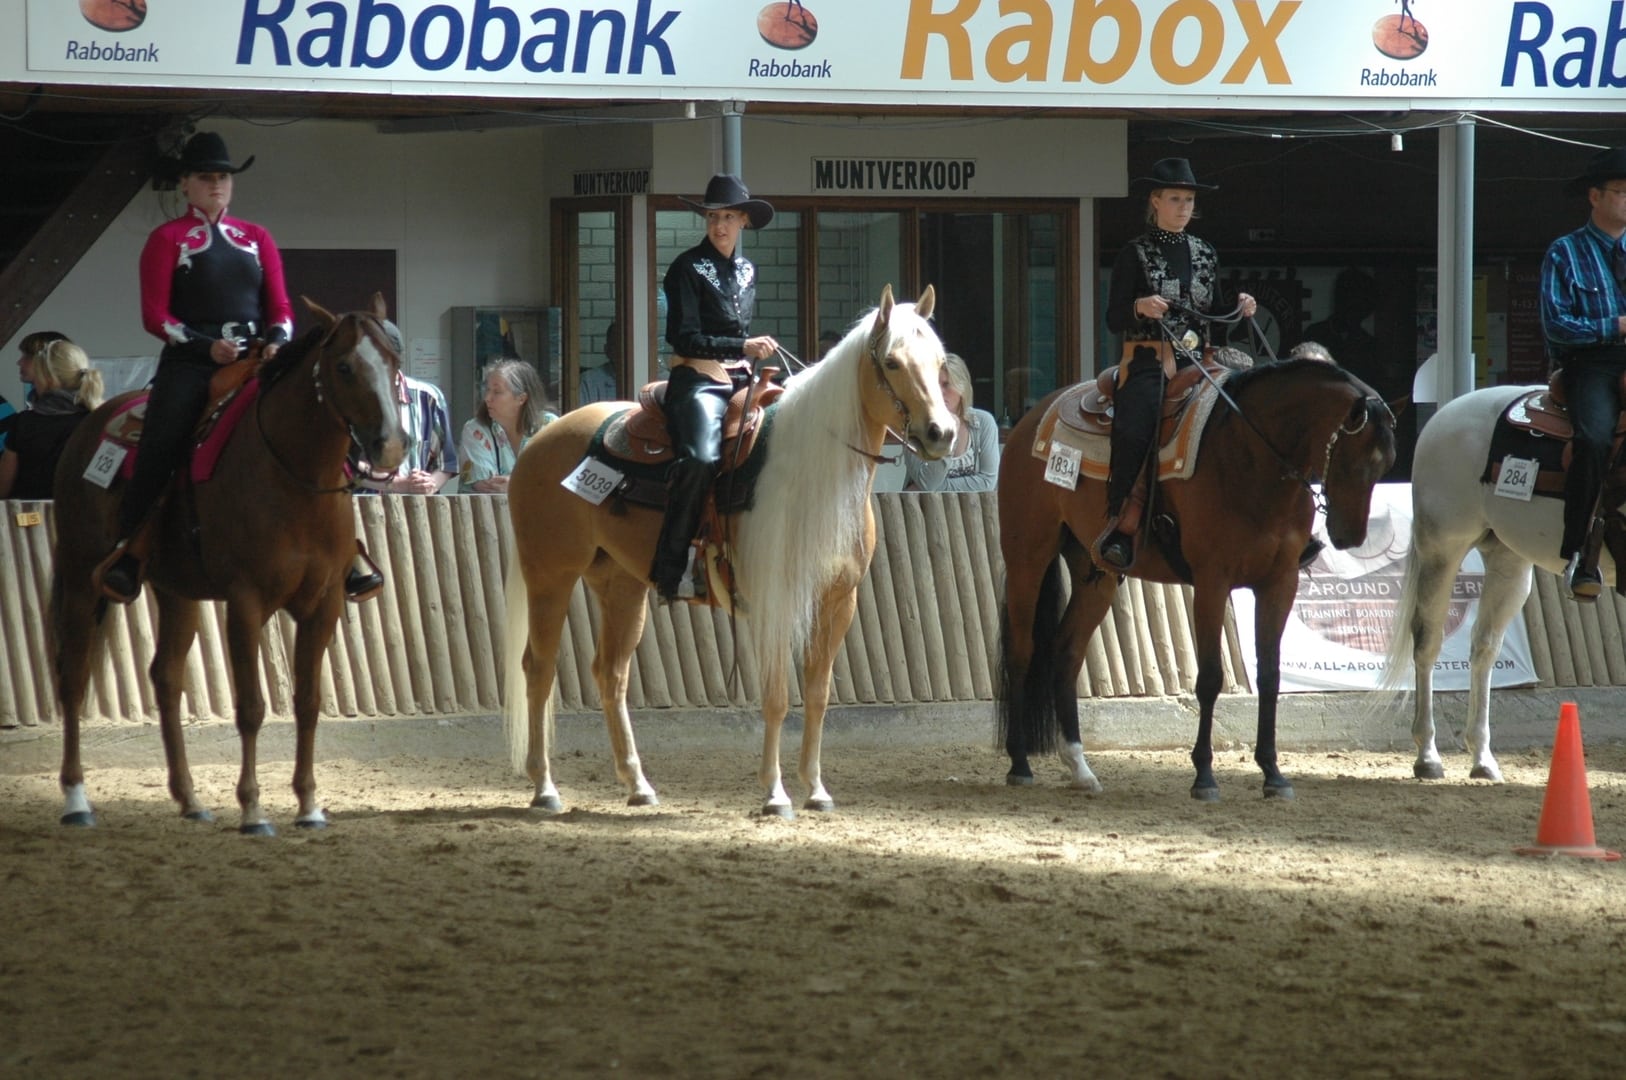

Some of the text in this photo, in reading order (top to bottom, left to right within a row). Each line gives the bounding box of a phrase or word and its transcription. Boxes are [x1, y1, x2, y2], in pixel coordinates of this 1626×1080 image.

[236, 0, 681, 75] Rabobank
[900, 0, 1301, 85] Rabox
[66, 41, 159, 63] Rabobank
[748, 58, 832, 79] Rabobank
[1360, 68, 1437, 87] Rabobank
[574, 170, 649, 195] MUNTVERKOOP
[815, 159, 976, 191] MUNTVERKOOP
[95, 454, 113, 474] 129
[1050, 454, 1075, 477] 1834
[576, 468, 613, 494] 5039
[1503, 468, 1528, 487] 284
[1308, 581, 1391, 596] AROUND
[1302, 608, 1399, 619] TRAINING BOARDIN
